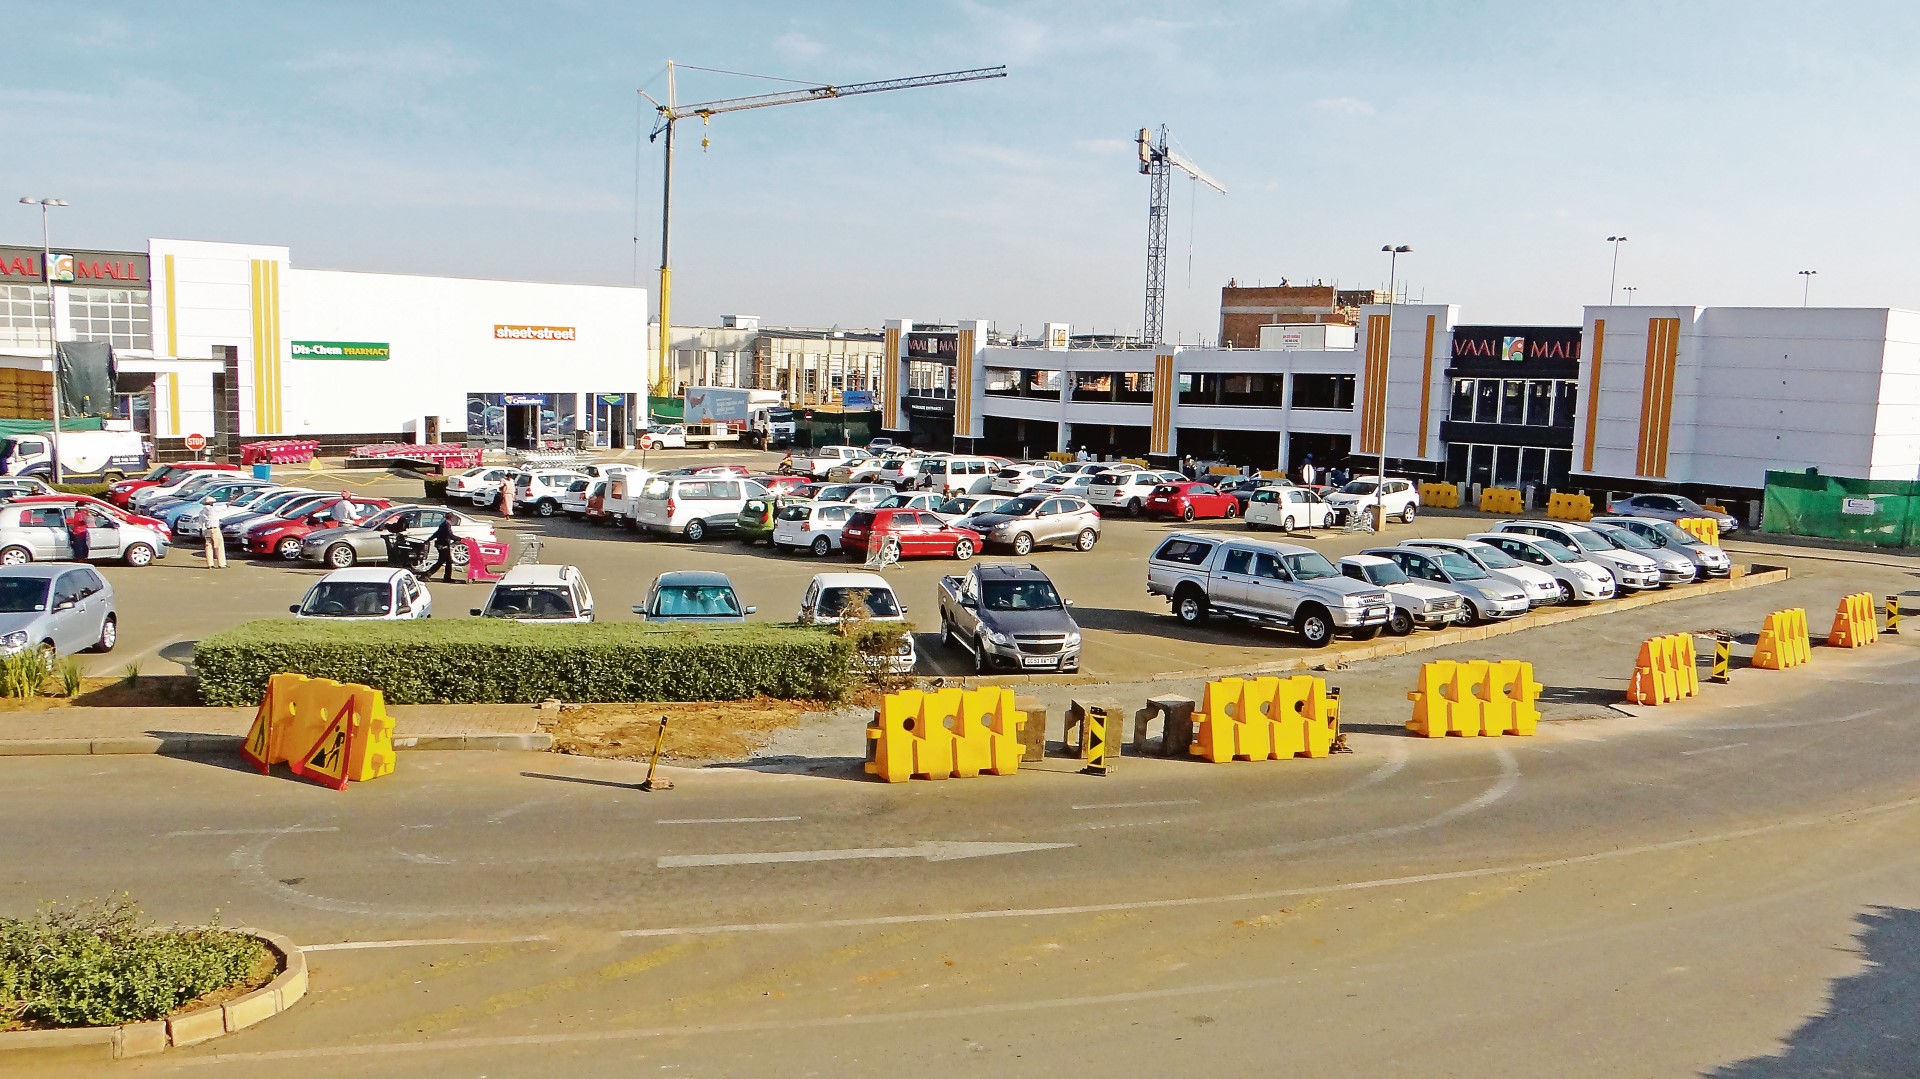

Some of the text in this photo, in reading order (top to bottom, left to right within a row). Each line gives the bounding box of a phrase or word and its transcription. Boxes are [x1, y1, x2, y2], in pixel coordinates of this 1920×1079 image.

[0, 256, 140, 280] AAL MALL
[292, 344, 388, 355] Dis-Chem PHARMACY
[1454, 340, 1498, 356] VAAL
[187, 438, 204, 446] STOP
